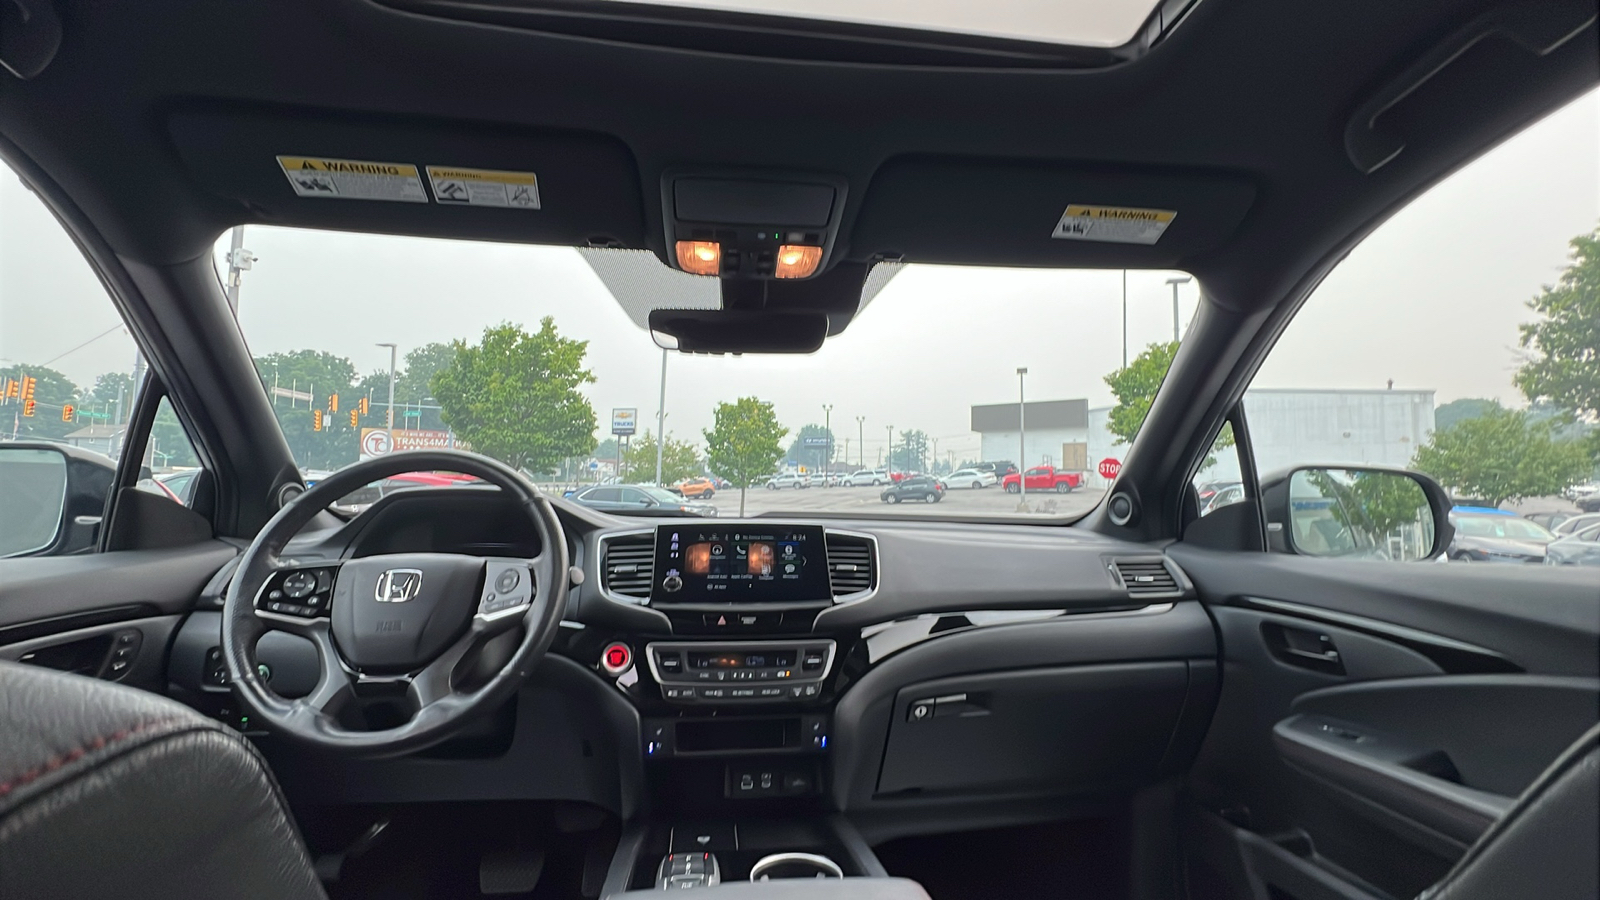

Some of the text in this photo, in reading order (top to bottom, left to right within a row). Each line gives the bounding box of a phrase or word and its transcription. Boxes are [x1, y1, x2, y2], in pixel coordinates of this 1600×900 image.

[322, 161, 399, 175] WARNING
[1099, 210, 1158, 220] WARNING
[1100, 463, 1121, 474] STOP
